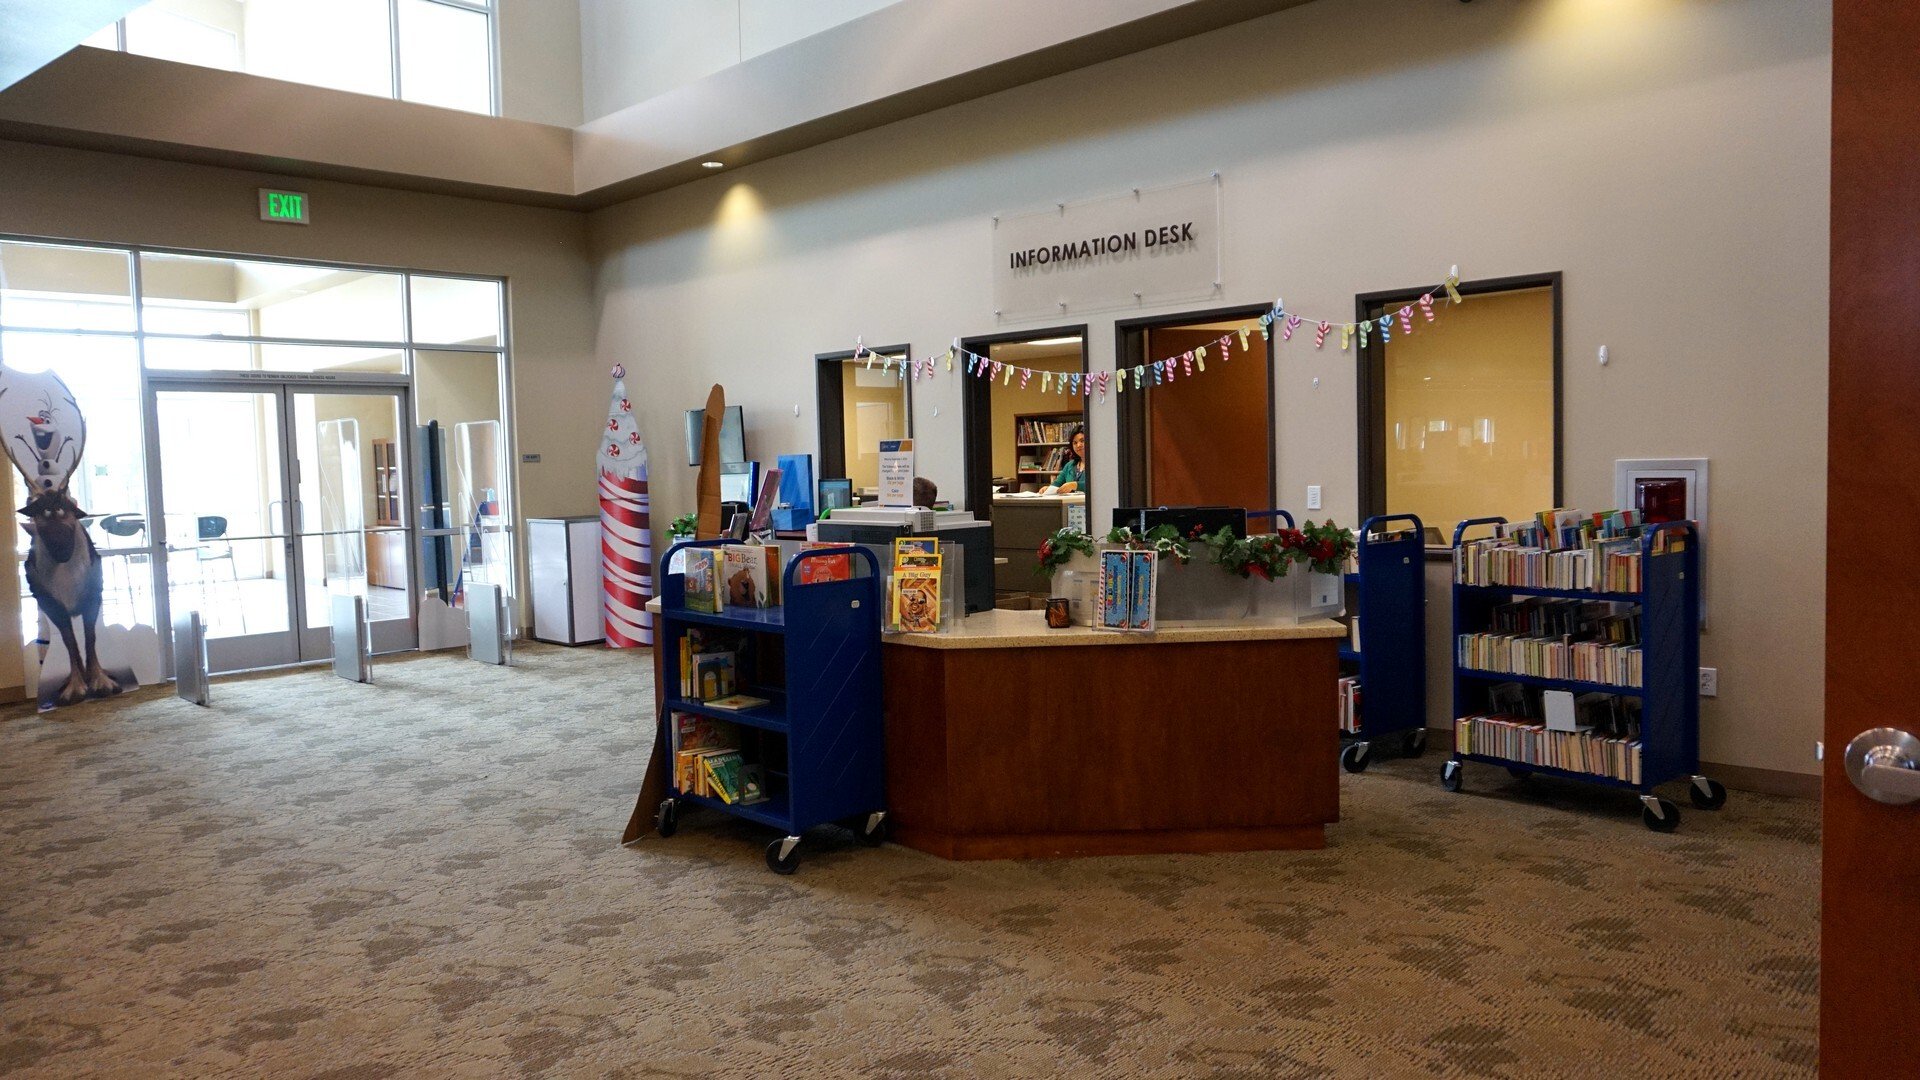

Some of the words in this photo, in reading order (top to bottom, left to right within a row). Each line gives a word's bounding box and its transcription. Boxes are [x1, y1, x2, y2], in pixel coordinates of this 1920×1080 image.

[269, 193, 302, 219] EXIT
[1010, 232, 1136, 269] INFORMATION
[1145, 222, 1194, 247] DESK
[728, 553, 741, 563] BIG
[919, 571, 932, 579] Guy
